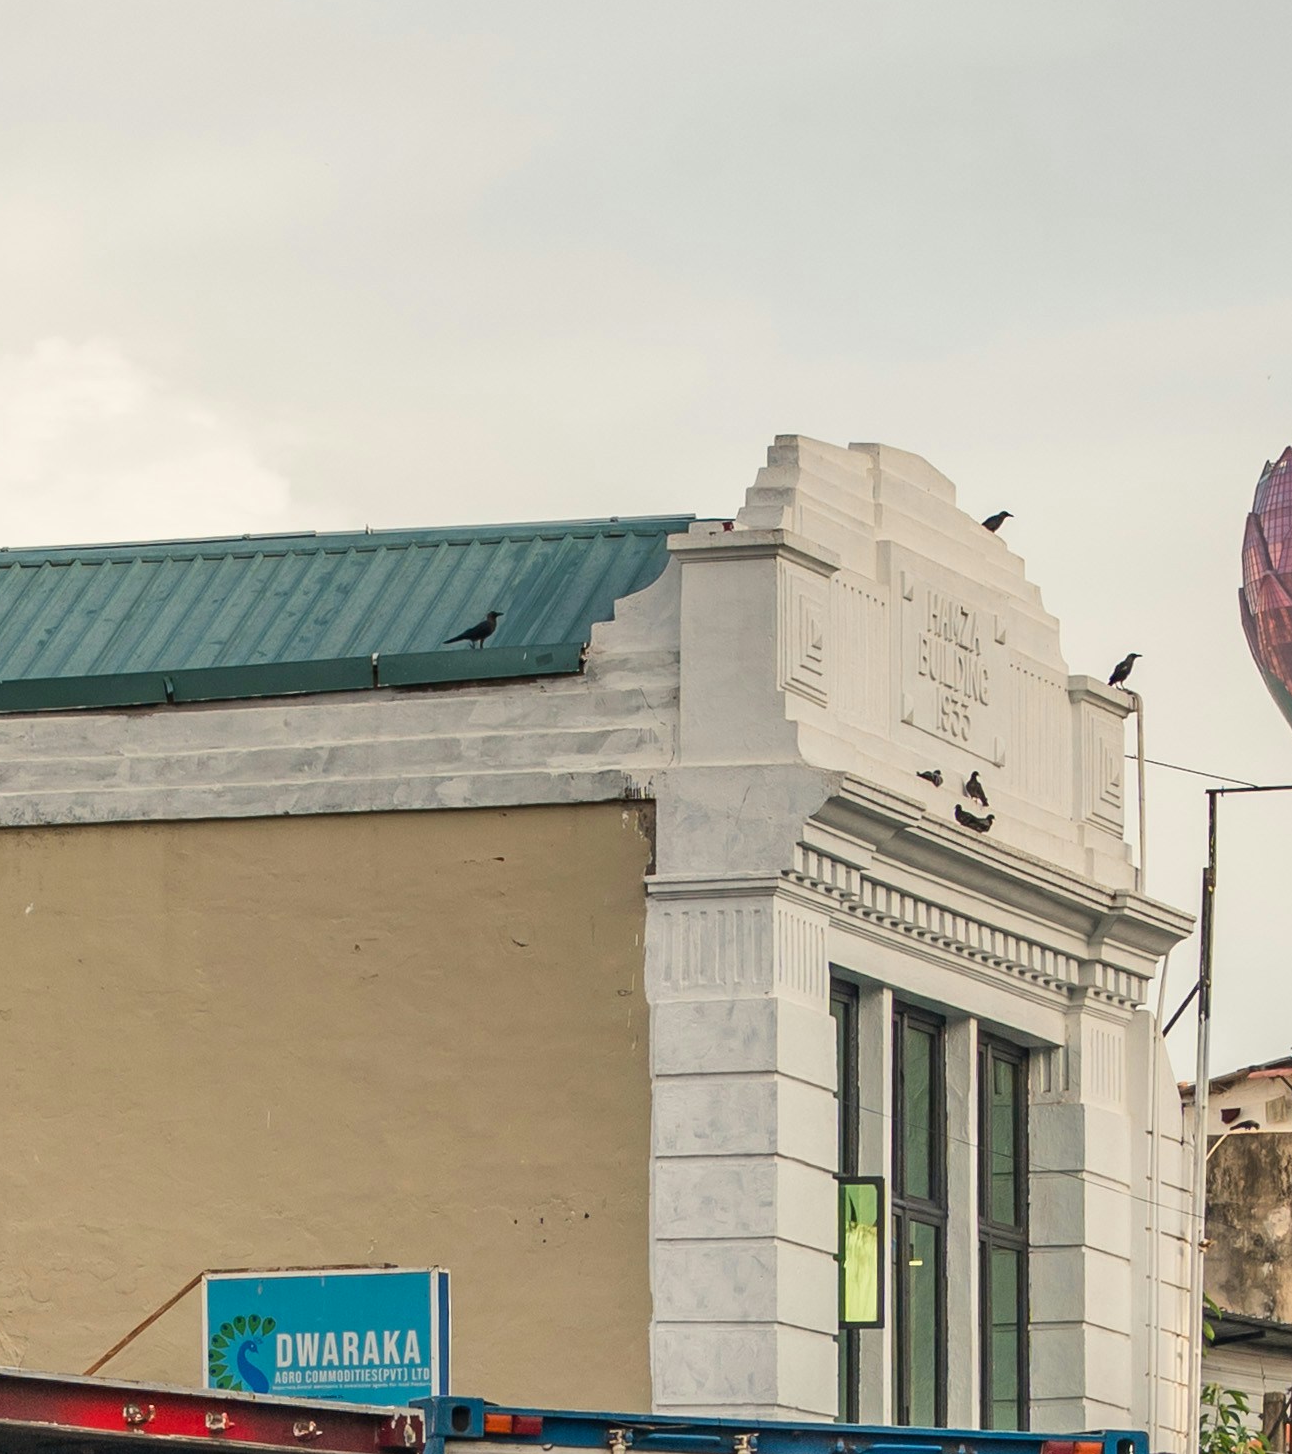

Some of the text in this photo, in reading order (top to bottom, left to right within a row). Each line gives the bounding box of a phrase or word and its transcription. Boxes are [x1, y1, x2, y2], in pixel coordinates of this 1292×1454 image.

[926, 590, 981, 657] HAMZA
[918, 631, 989, 707] BUILDING
[935, 686, 971, 742] 1933
[274, 1367, 430, 1384] AGRO COMMODITIES(PVT) LTD
[276, 1330, 421, 1368] DWARAKA
